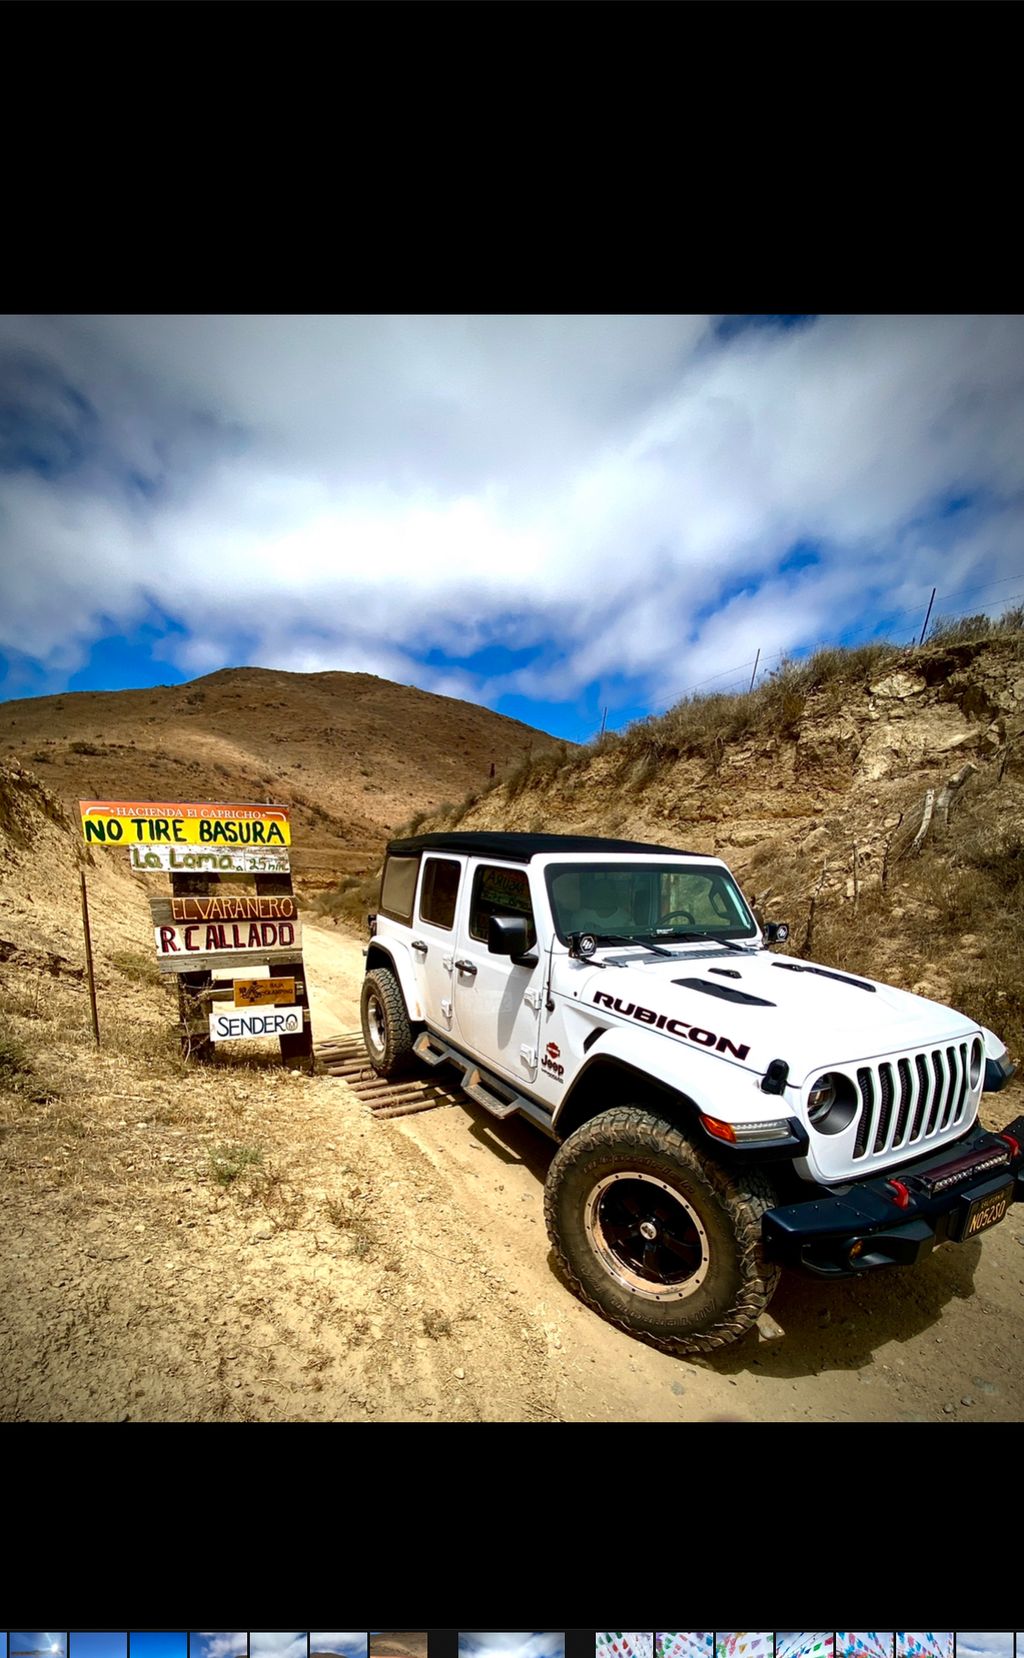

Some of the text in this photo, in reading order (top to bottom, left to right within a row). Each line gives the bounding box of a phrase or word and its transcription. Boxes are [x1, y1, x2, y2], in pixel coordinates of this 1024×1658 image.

[116, 806, 183, 818] HACIENDA
[200, 808, 261, 820] CAPRICHO
[84, 818, 286, 844] NO TIRE BASURA
[171, 898, 198, 920] EL
[216, 1013, 298, 1038] SENDERO
[593, 991, 751, 1061] RUBICON
[541, 1055, 564, 1076] Jeep
